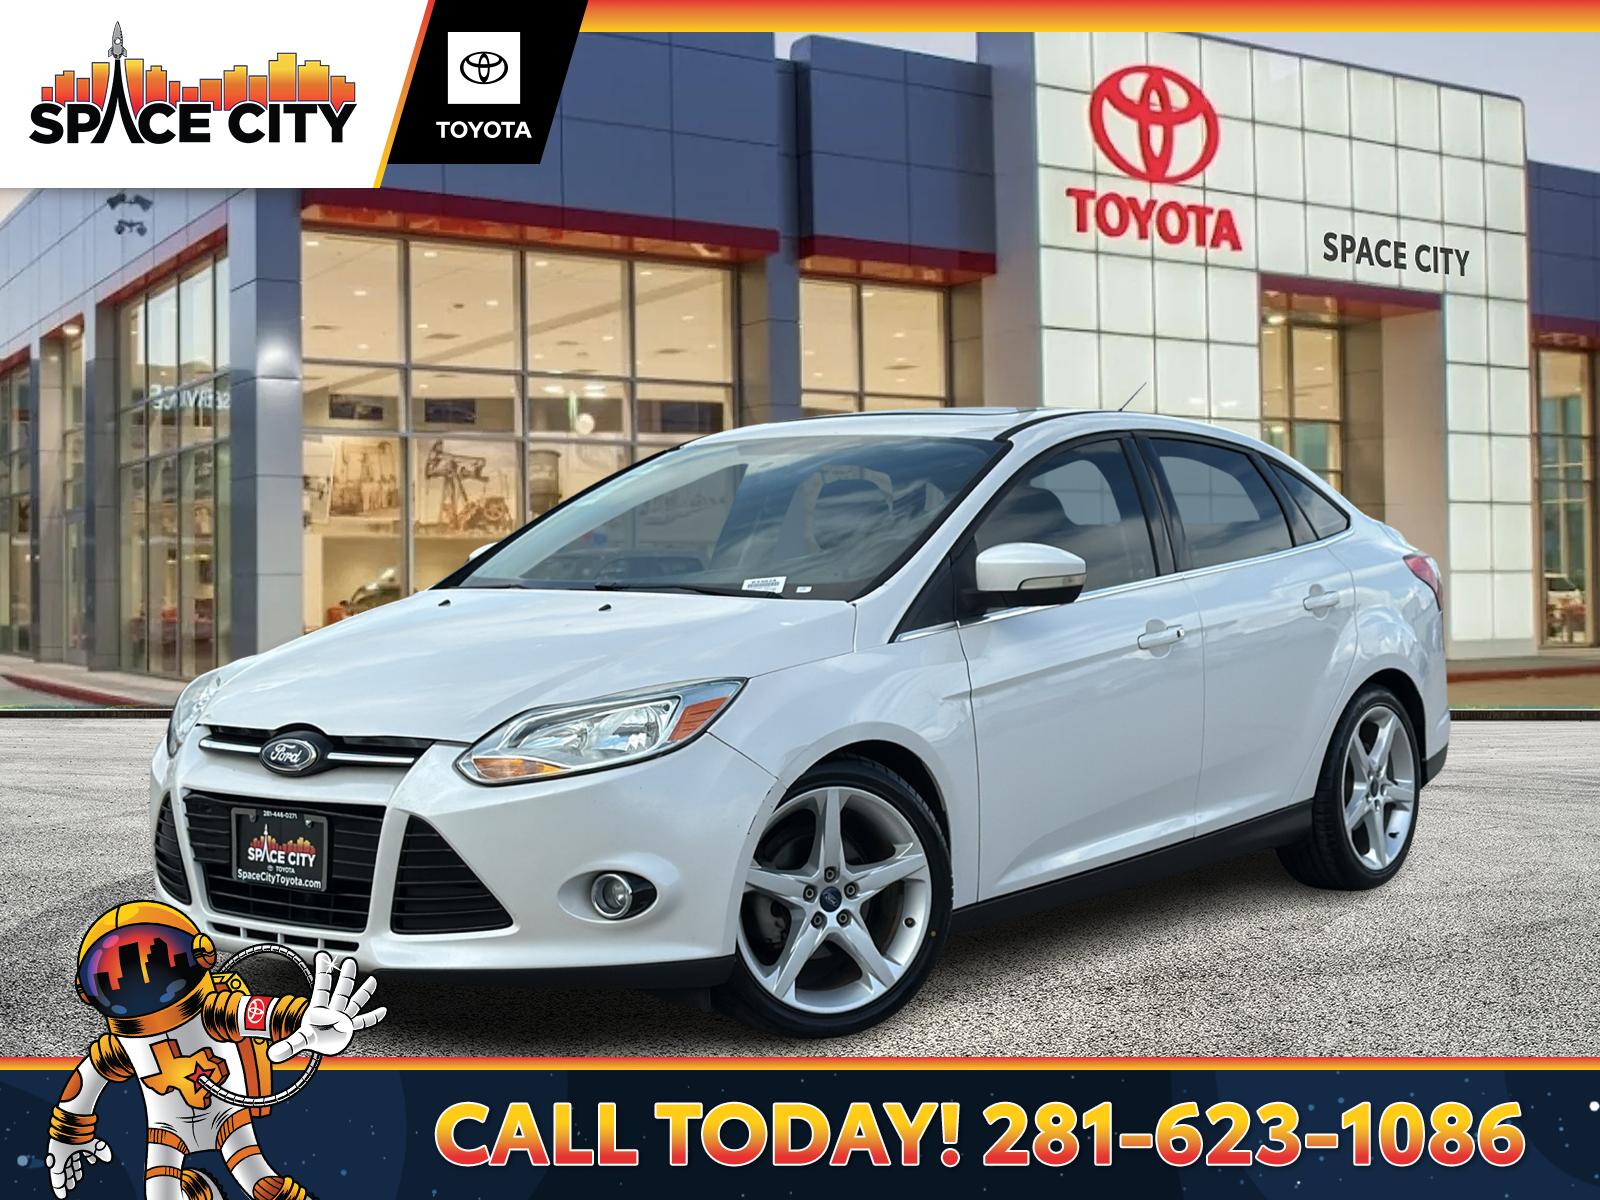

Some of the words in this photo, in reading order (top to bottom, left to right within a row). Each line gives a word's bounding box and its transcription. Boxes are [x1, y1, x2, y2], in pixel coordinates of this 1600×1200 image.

[1066, 187, 1242, 252] TOYOTA
[1323, 232, 1407, 270] SPACE
[1415, 244, 1470, 277] CITY
[270, 743, 302, 764] Ford
[247, 837, 286, 864] SPACE
[288, 851, 316, 867] CITY
[237, 868, 322, 889] SpaceCityToyota.com
[275, 865, 296, 874] TOYOTA
